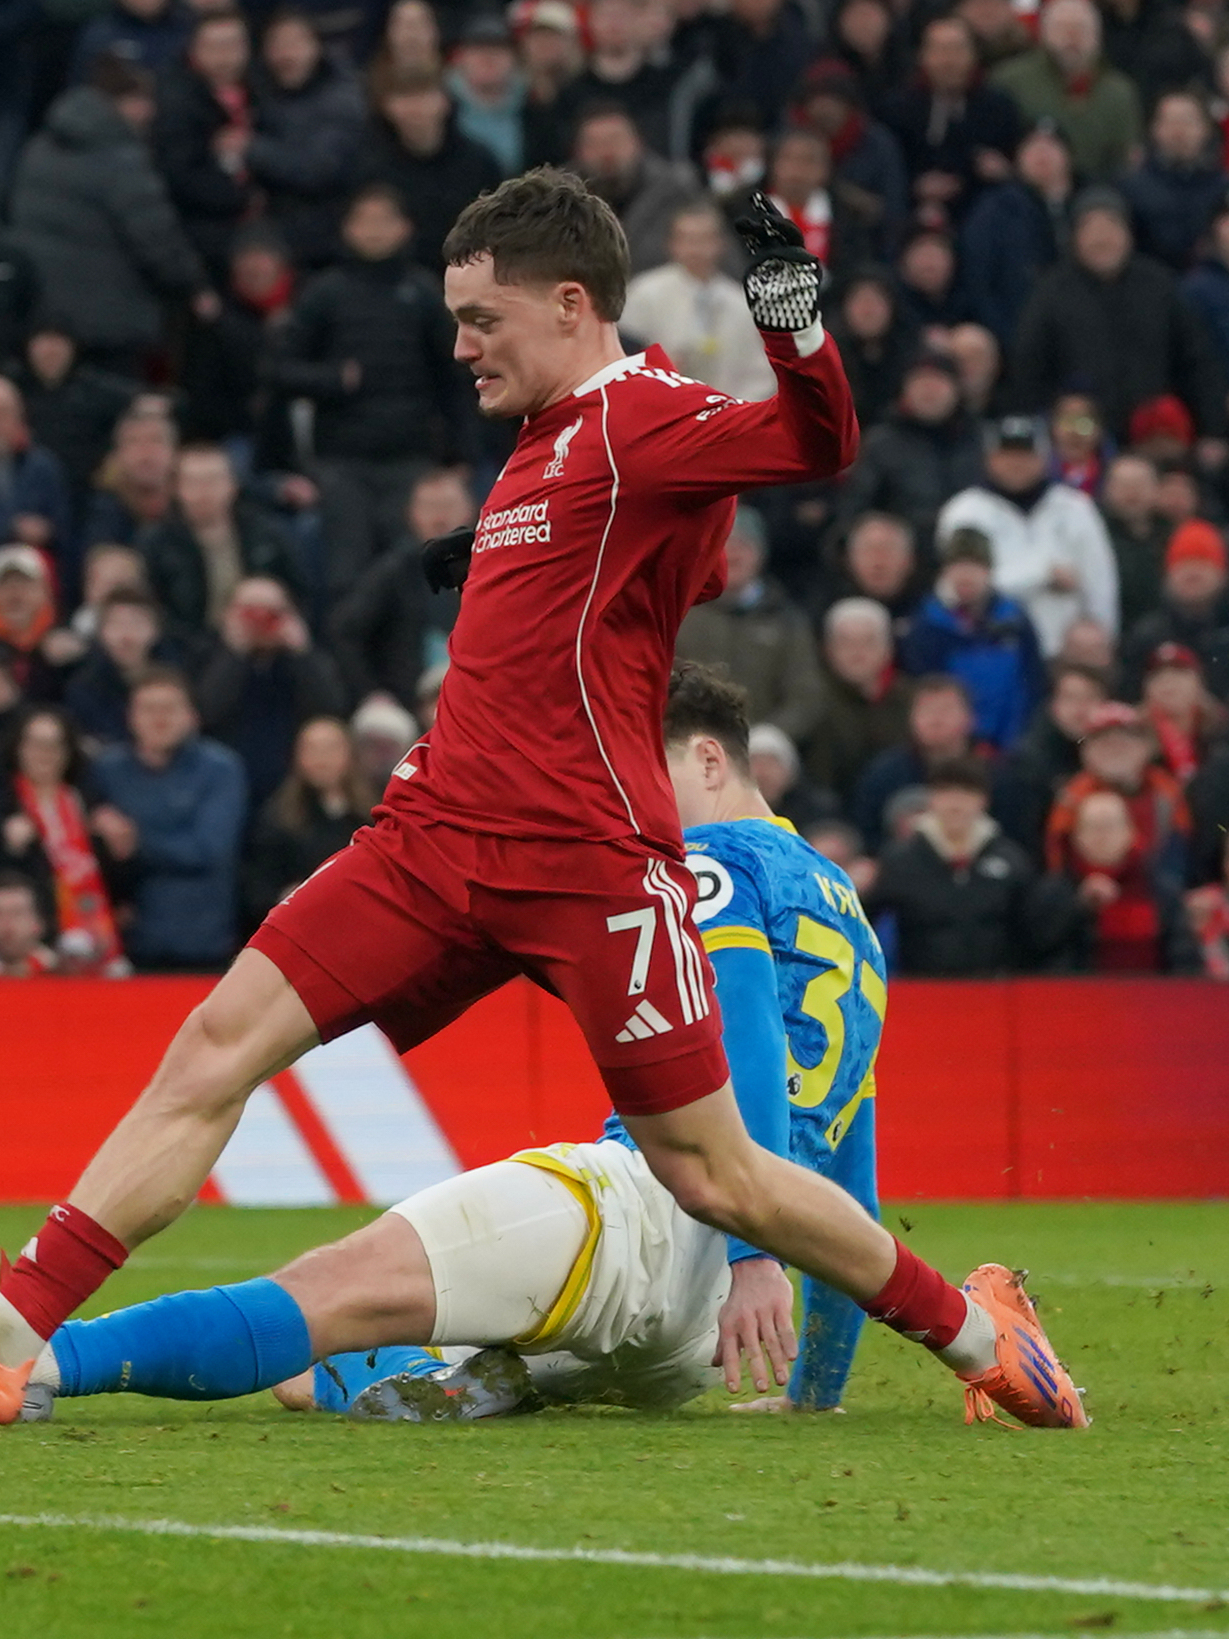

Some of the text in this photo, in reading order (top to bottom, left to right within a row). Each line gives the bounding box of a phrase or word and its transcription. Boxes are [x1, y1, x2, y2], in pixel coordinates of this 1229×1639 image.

[482, 499, 549, 531] standard
[476, 520, 552, 554] chartered
[606, 906, 656, 996] 7
